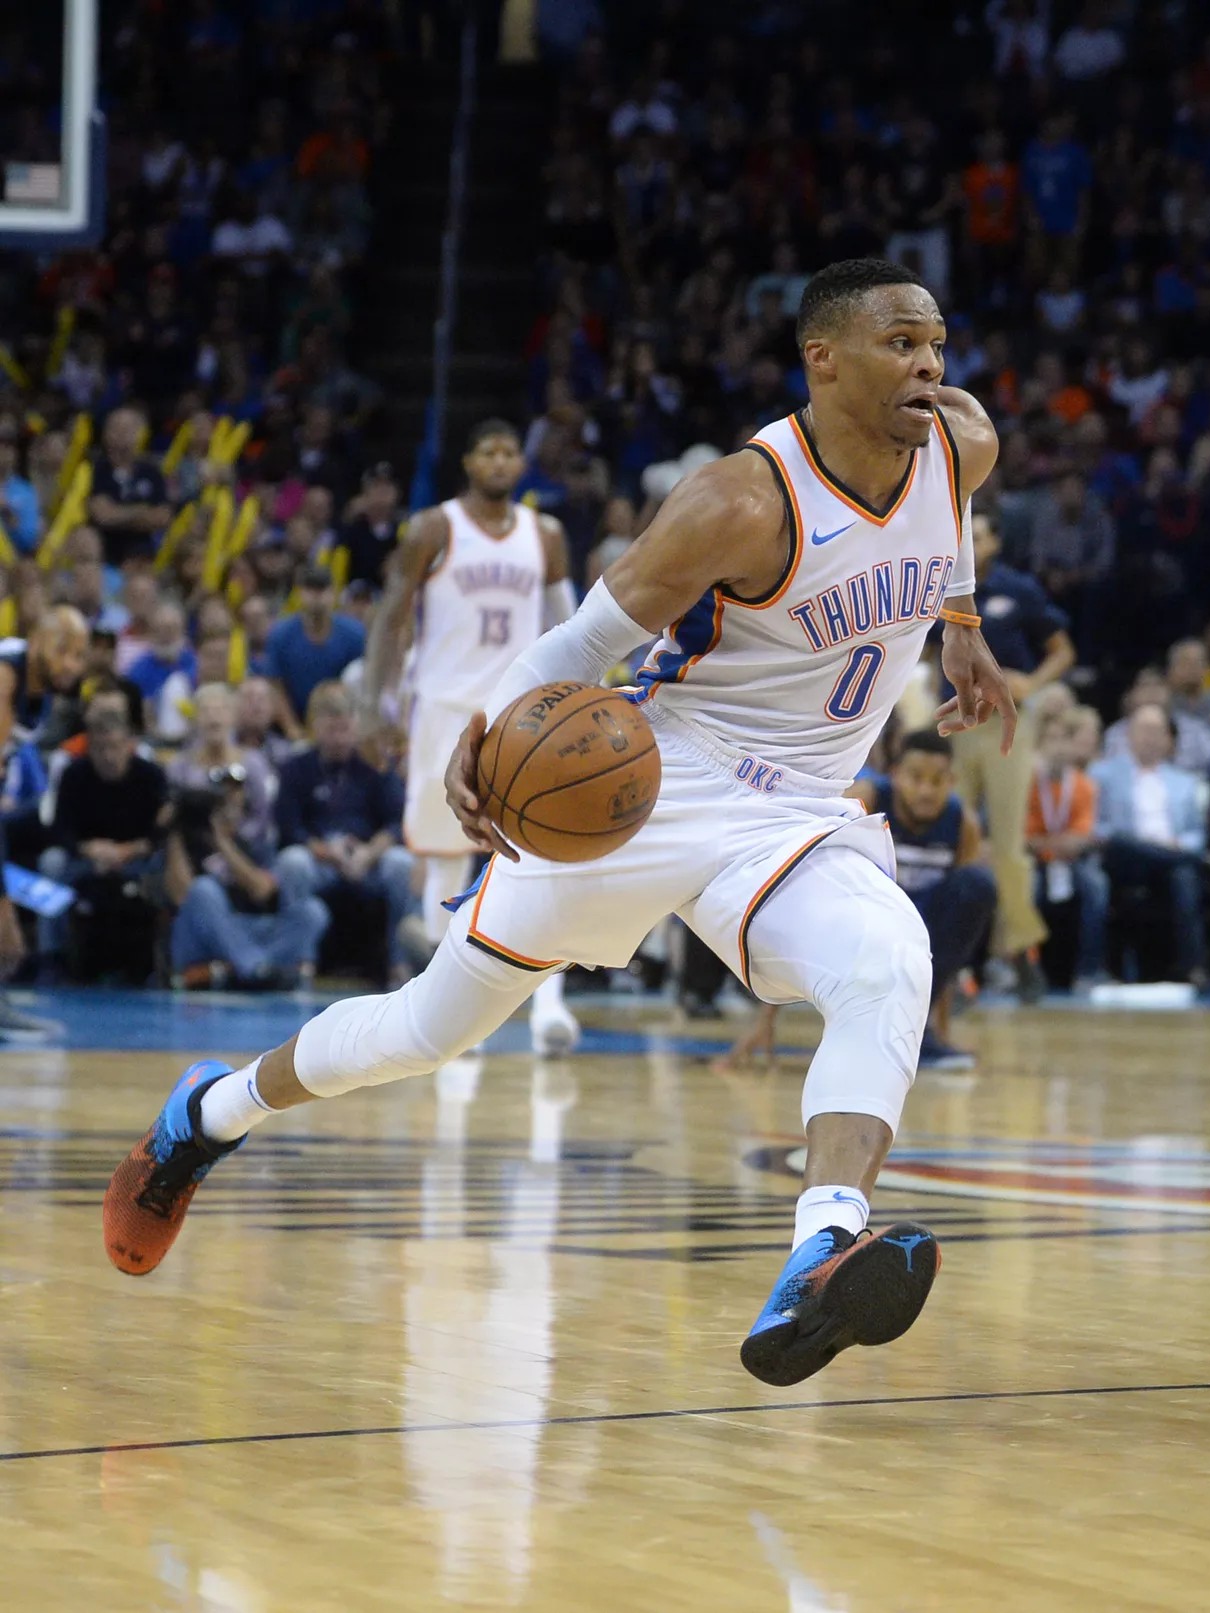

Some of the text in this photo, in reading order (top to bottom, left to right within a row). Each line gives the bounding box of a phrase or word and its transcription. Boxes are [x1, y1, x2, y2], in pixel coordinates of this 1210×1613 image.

[478, 606, 512, 648] 13
[824, 641, 886, 722] 0
[734, 755, 784, 793] OKC
